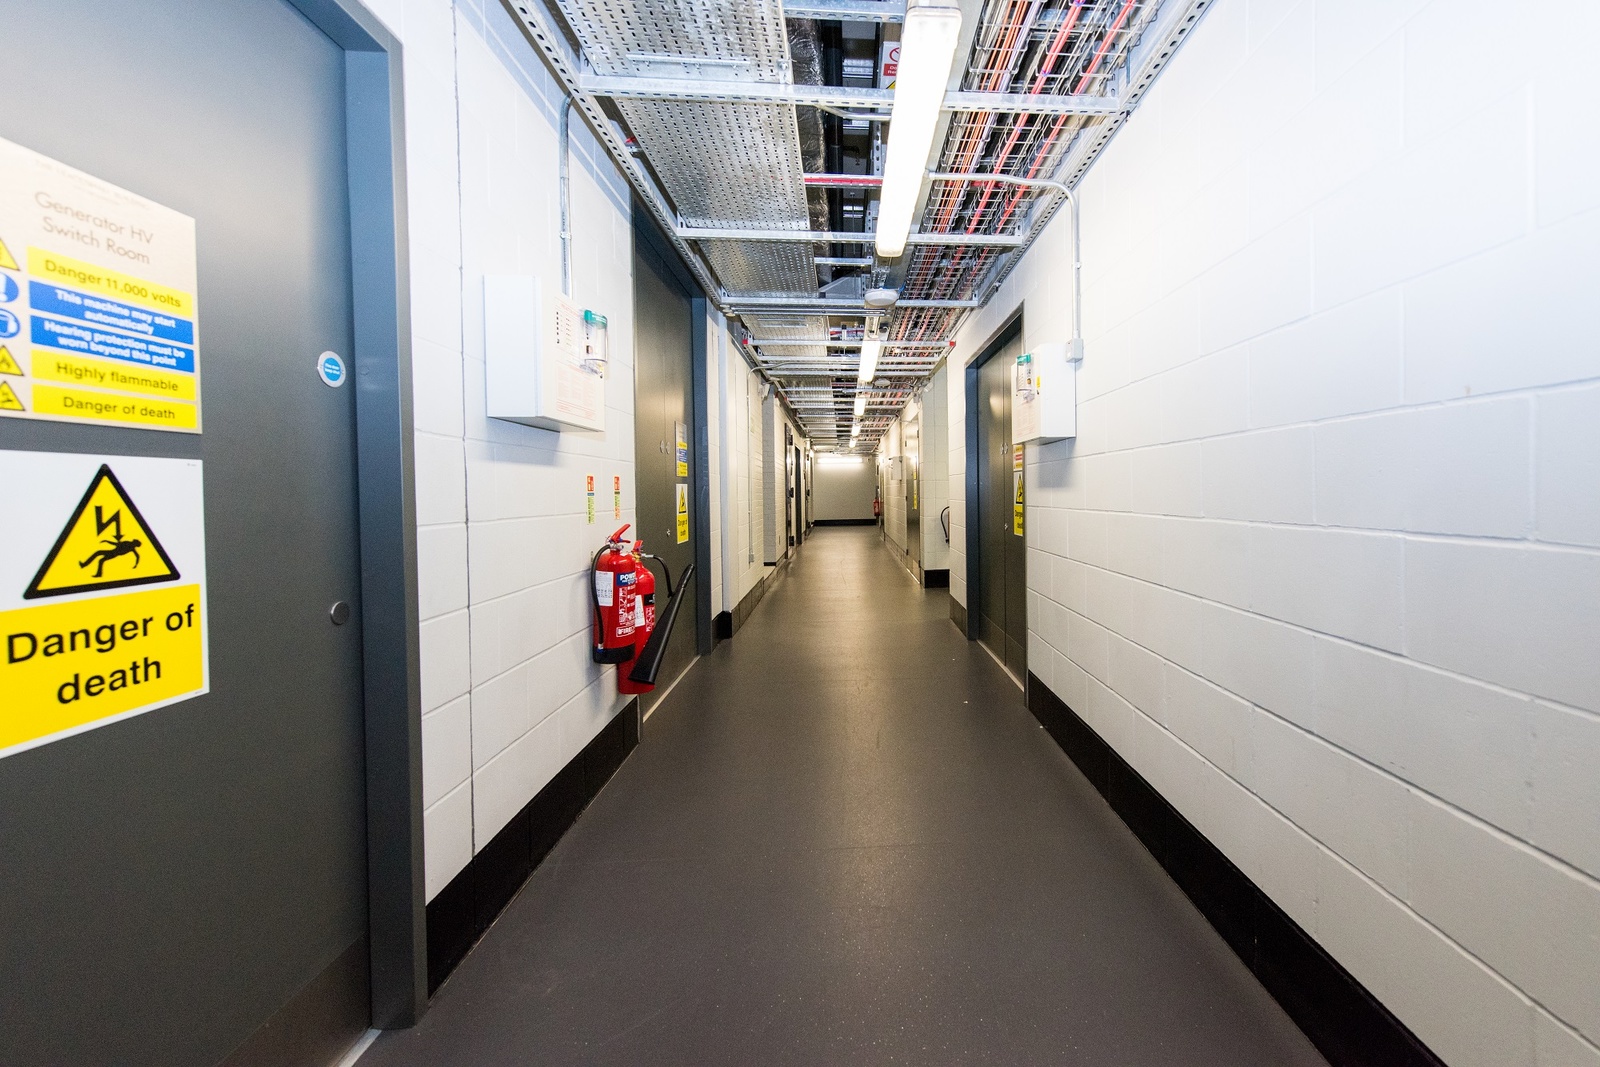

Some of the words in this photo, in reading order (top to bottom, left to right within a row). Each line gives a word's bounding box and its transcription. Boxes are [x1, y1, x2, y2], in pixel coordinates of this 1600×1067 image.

[35, 191, 124, 235] Generator
[131, 226, 153, 244] HV
[43, 216, 100, 248] Switch
[106, 238, 150, 264] Room
[45, 259, 101, 284] Danger
[152, 292, 181, 308] volts
[55, 289, 82, 305] This
[44, 320, 92, 341] Hearing
[93, 332, 147, 351] protection
[89, 341, 130, 357] beyond
[152, 355, 177, 367] point
[56, 362, 106, 382] Highly
[111, 371, 178, 392] flammable
[63, 396, 117, 414] Danger
[122, 404, 136, 414] of
[140, 404, 175, 419] death
[7, 616, 153, 664] Danger
[165, 603, 194, 631] of
[57, 656, 162, 705] death
